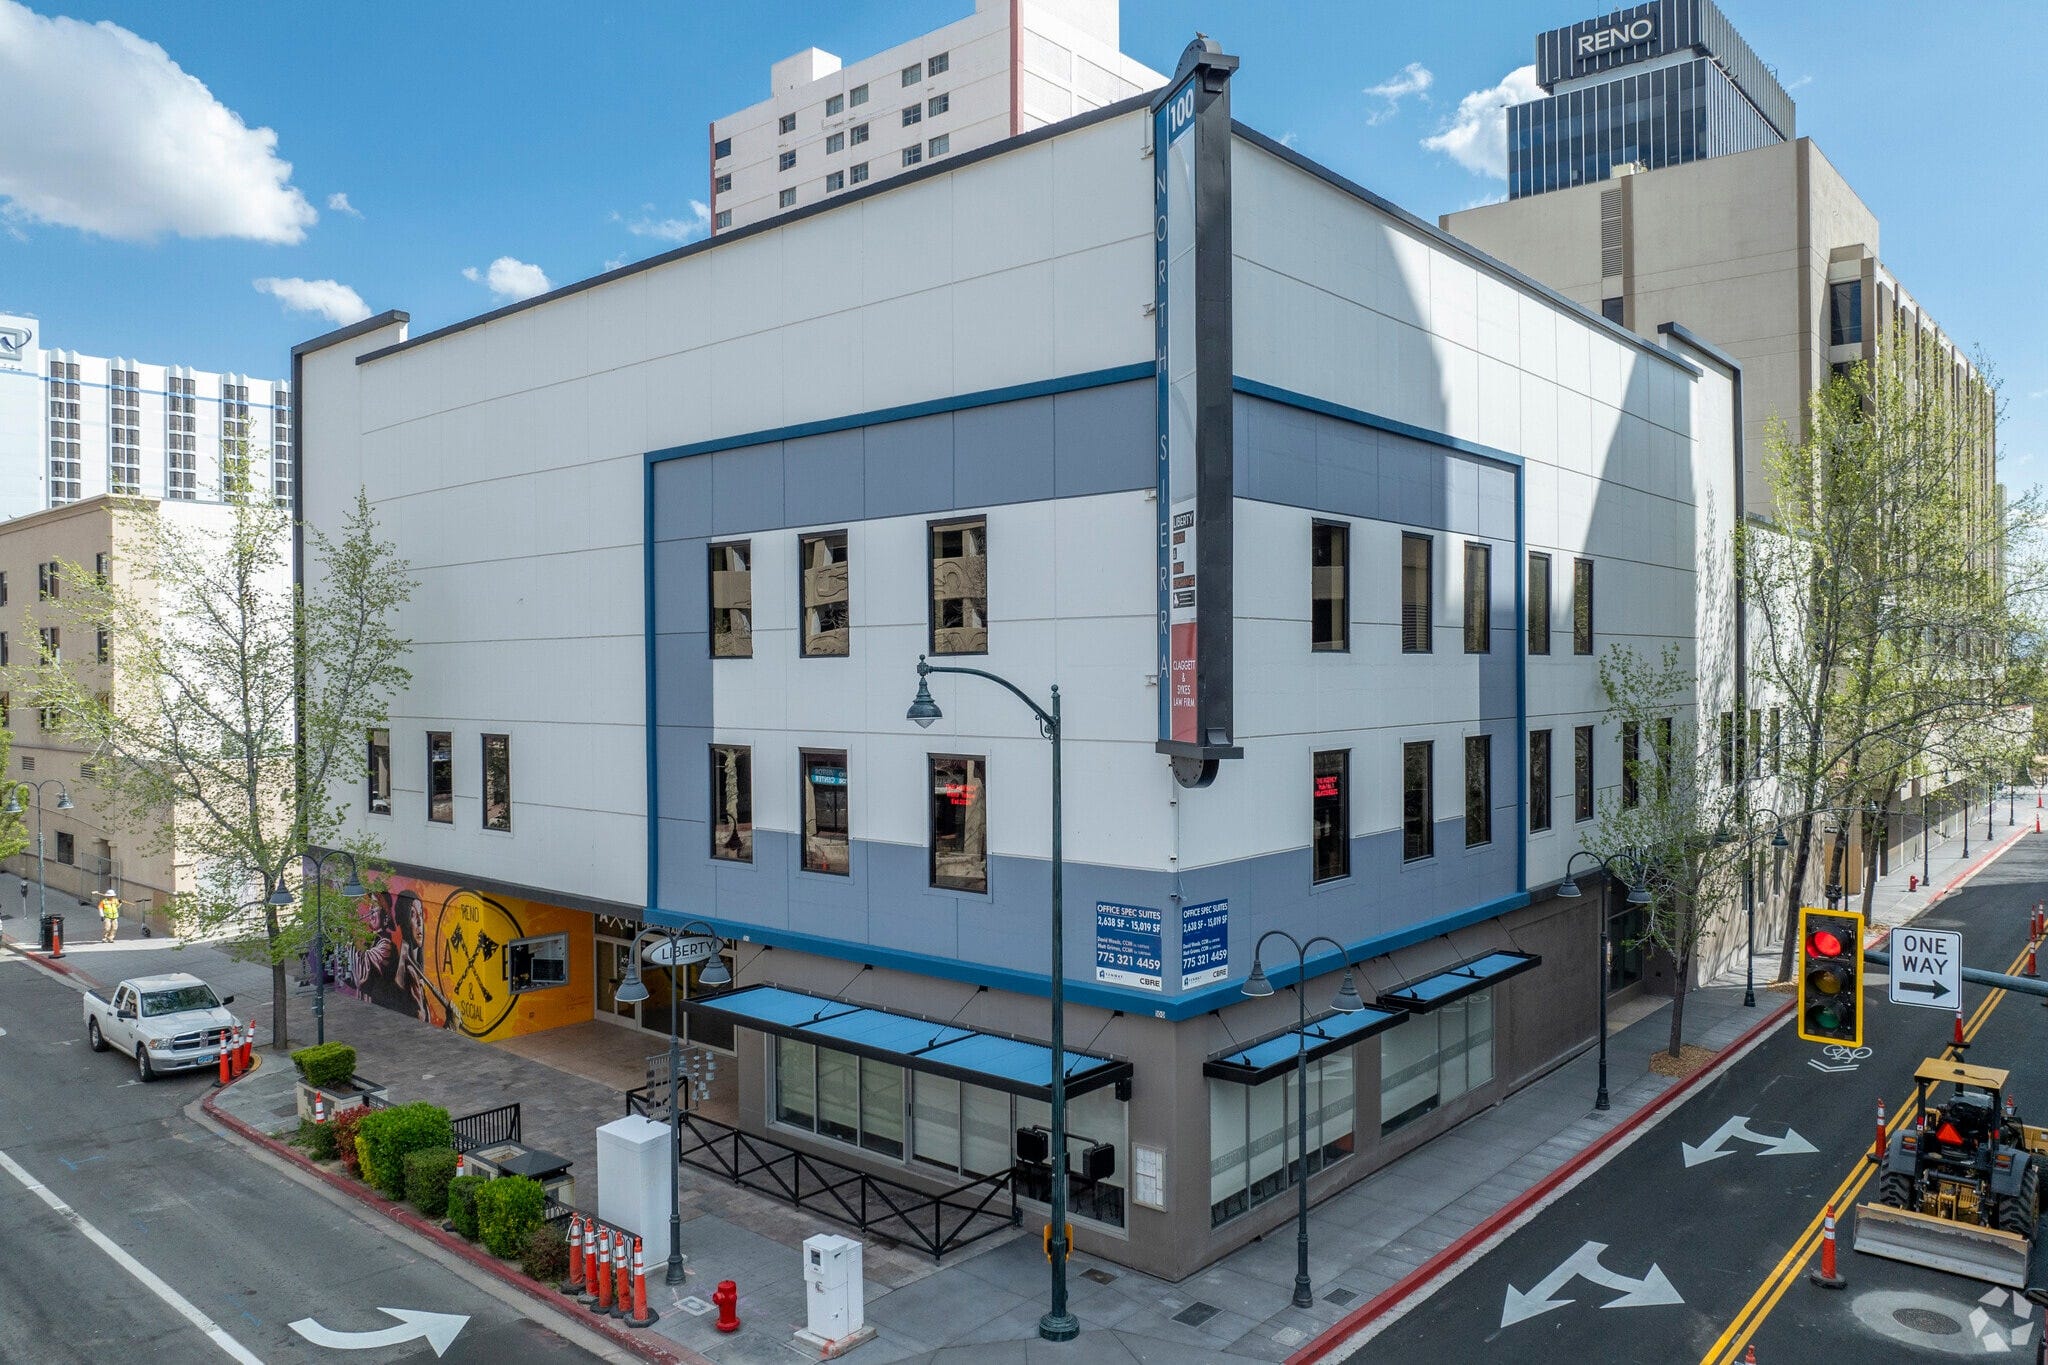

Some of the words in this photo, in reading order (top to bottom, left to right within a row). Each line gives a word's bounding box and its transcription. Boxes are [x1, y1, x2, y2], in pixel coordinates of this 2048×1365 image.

[1578, 20, 1652, 55] RENO
[1170, 88, 1194, 133] 100
[1156, 169, 1168, 374] NORTH
[1173, 513, 1194, 529] LIBERTY
[1159, 434, 1169, 678] SIERRA
[1173, 660, 1196, 670] CLAGGETT
[1182, 672, 1186, 682] &
[1177, 685, 1190, 695] SYKES
[1174, 698, 1182, 706] LAW
[1184, 698, 1194, 707] FIRM
[461, 904, 480, 922] RENO
[1098, 905, 1120, 915] OFFICE
[1121, 908, 1137, 916] SPEC
[1139, 910, 1160, 920] SUITES
[1184, 908, 1200, 918] OFFICE
[1201, 905, 1212, 915] SPEC
[1213, 903, 1227, 913] SUITES
[1098, 916, 1115, 927] 2,638
[1117, 920, 1124, 928] SF
[1131, 921, 1151, 932] 15,019
[1153, 924, 1160, 932] SF
[1198, 920, 1203, 929] SF
[1222, 915, 1227, 924] SF
[662, 941, 714, 960] LIBERTY
[1904, 935, 1947, 955] ONE
[1098, 952, 1114, 963] 775
[1117, 955, 1133, 966] 321
[1137, 958, 1160, 970] 4459
[1183, 957, 1196, 969] 775
[1197, 954, 1209, 966] 321
[1211, 950, 1227, 962] 4459
[1902, 955, 1948, 975] WAY
[1213, 969, 1226, 977] CBRE
[1140, 978, 1160, 987] CBRE
[469, 983, 474, 1000] &
[461, 1000, 484, 1022] SOCIAL
